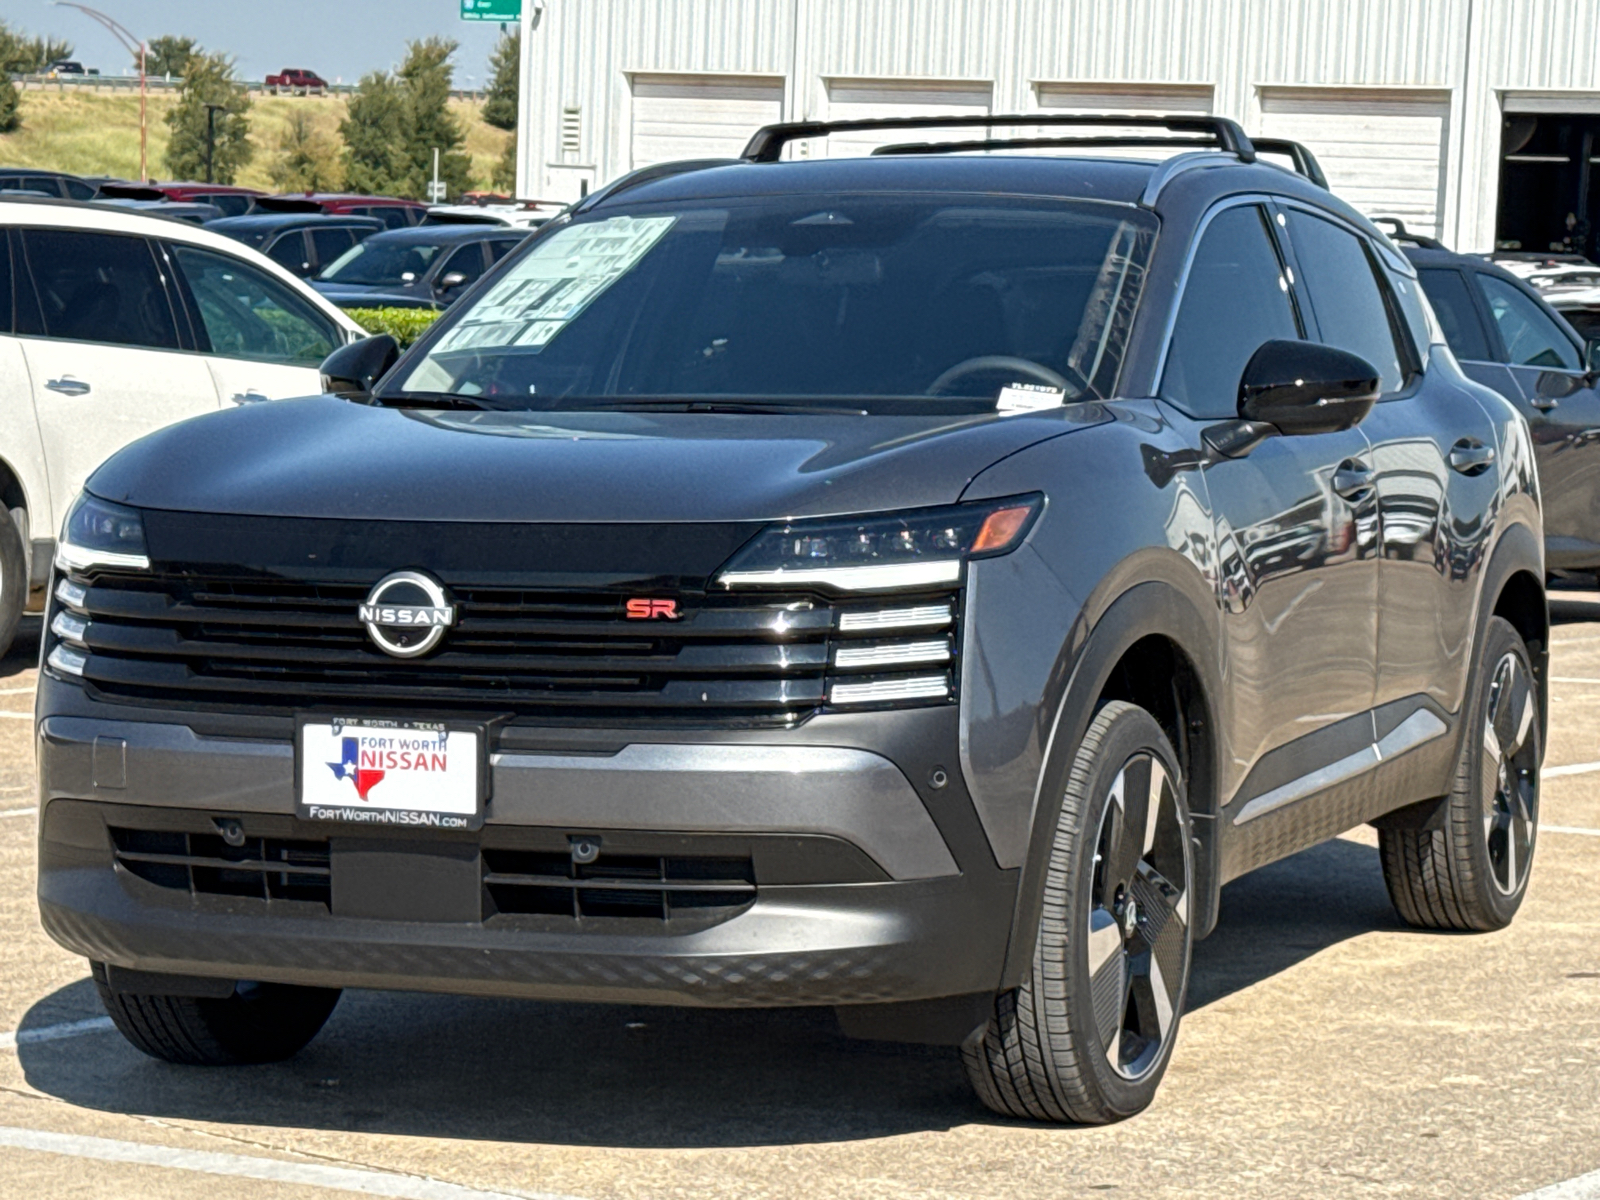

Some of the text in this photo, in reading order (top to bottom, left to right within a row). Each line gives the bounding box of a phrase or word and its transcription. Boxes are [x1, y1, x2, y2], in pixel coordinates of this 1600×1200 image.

[360, 605, 451, 624] NISSAN
[626, 599, 678, 618] SR
[333, 717, 445, 731] FORT WORTH TEXAS
[361, 737, 447, 752] FORT WORTH
[361, 750, 447, 772] NISSAN
